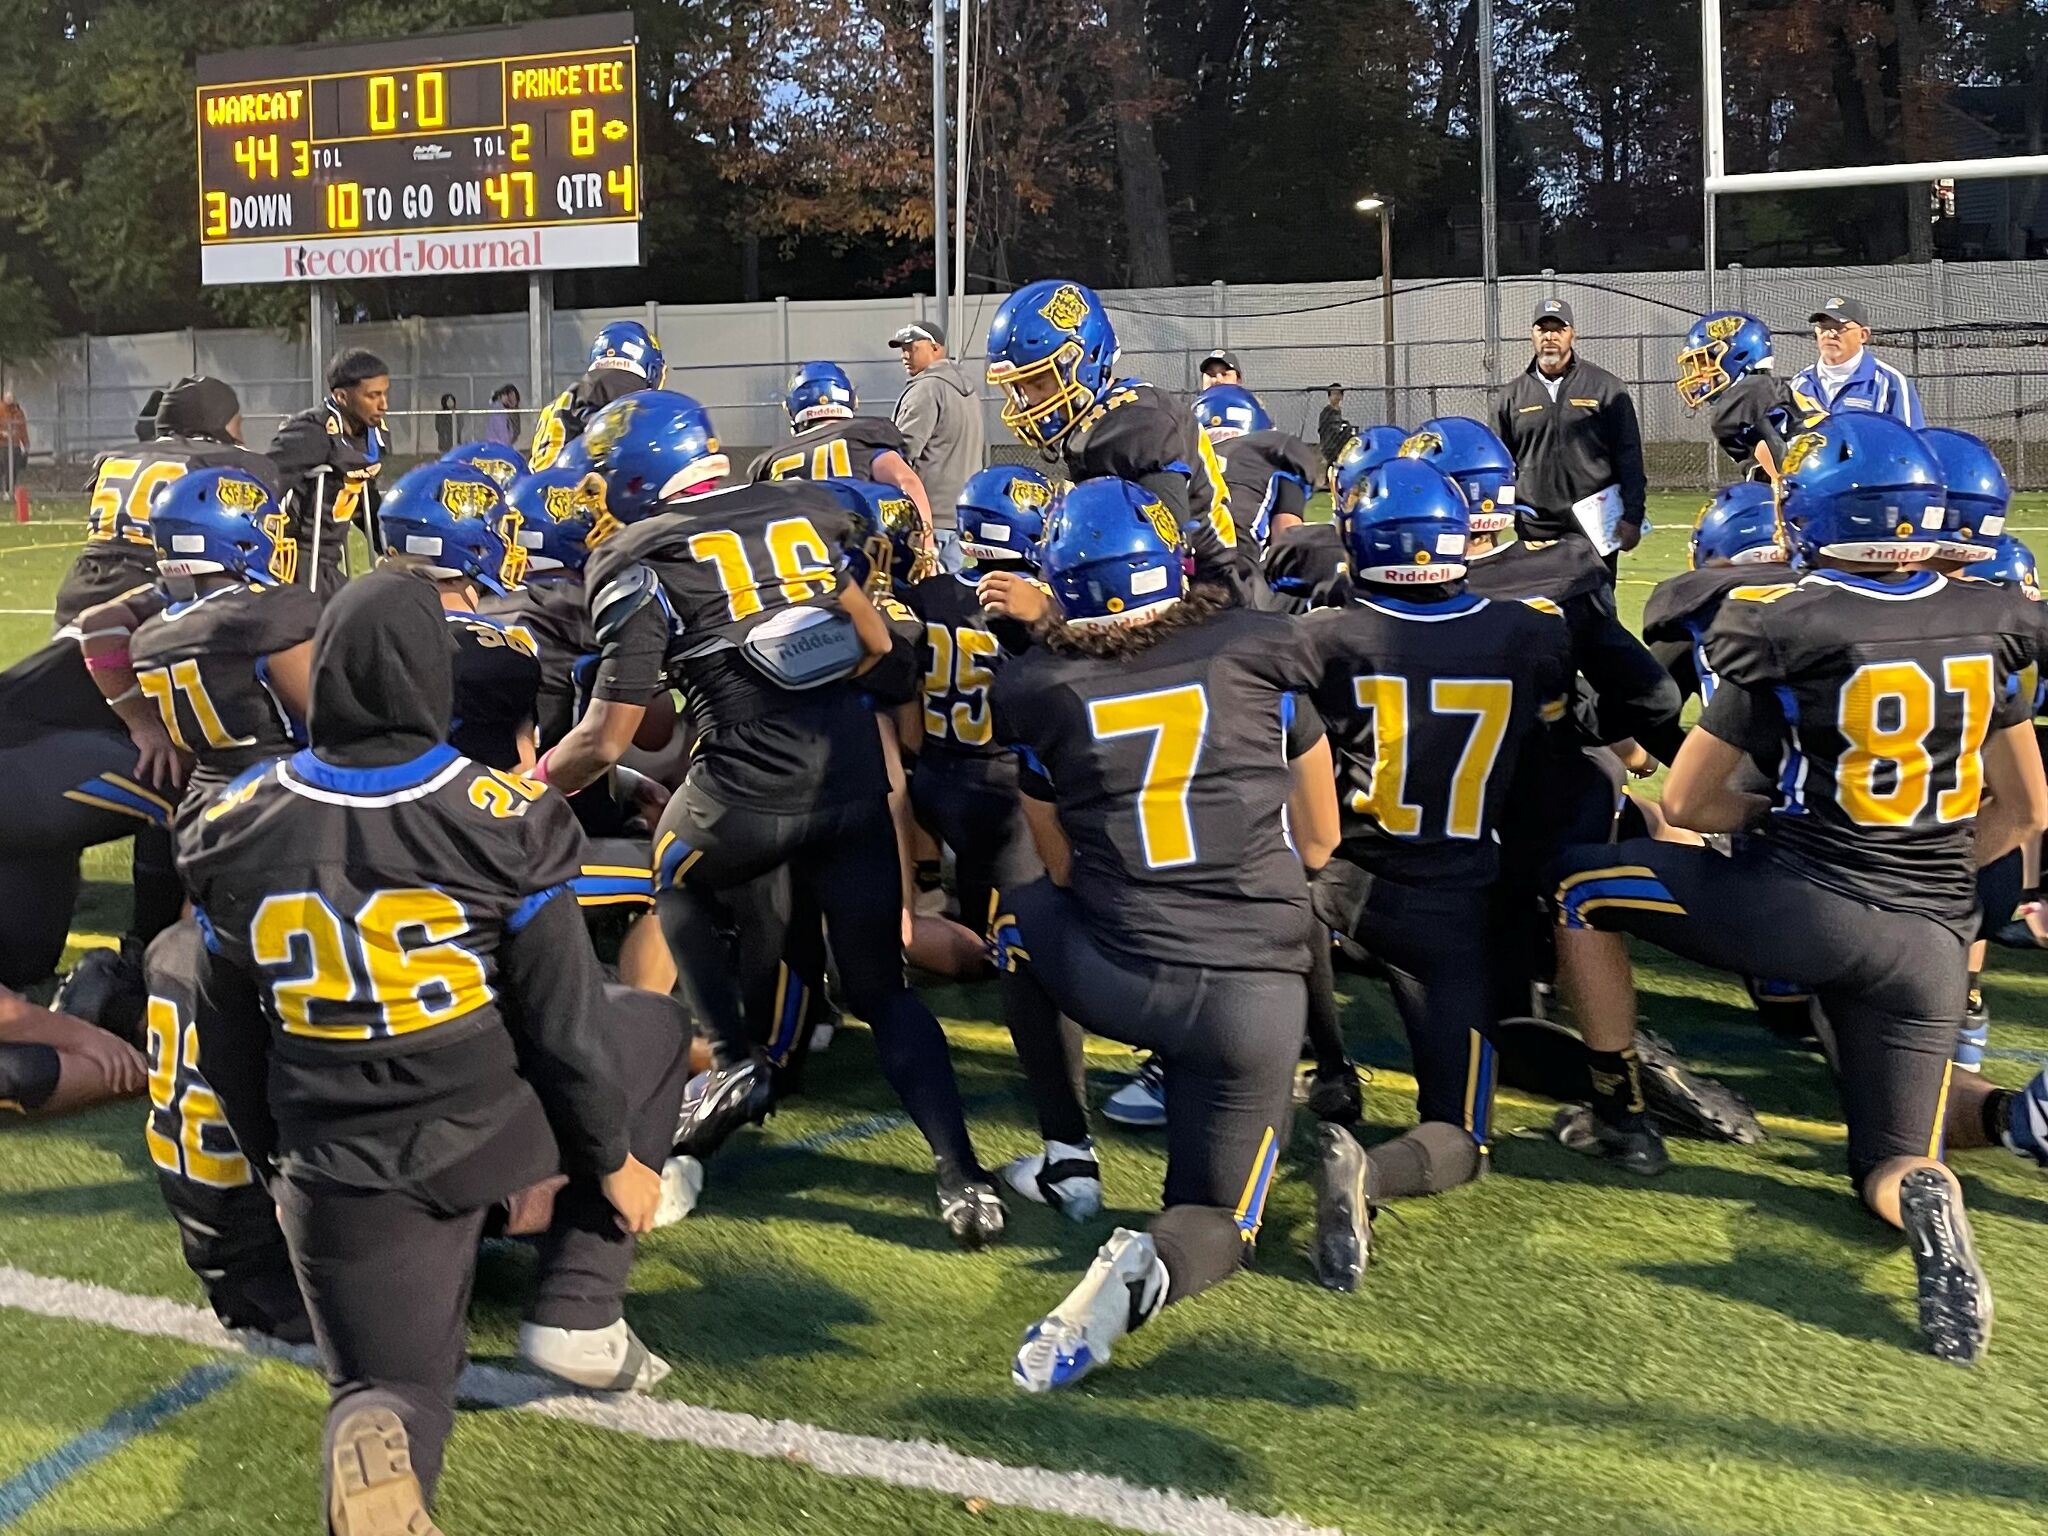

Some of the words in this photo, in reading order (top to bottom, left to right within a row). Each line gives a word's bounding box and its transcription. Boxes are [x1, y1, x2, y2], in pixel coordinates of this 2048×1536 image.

[206, 89, 303, 126] WARCAT
[369, 71, 443, 131] 0:0
[473, 135, 506, 158] TOL
[510, 122, 530, 162] 2
[570, 108, 595, 157] 8
[234, 133, 279, 180] 44
[290, 140, 310, 177] 3
[312, 147, 342, 169] TOL
[327, 182, 359, 229] 10
[362, 187, 393, 222] TO
[402, 183, 434, 220] GO
[448, 180, 482, 217] ON
[485, 171, 535, 219] 47
[556, 172, 604, 216] QTR
[607, 164, 633, 213] 4
[205, 191, 228, 237] 3
[229, 192, 293, 230] DOWN
[283, 230, 543, 278] Record-Journal
[806, 406, 844, 419] Riddell
[1470, 517, 1508, 530] ddell
[1384, 568, 1451, 583] Riddell
[1861, 547, 1931, 561] Riddell
[1936, 547, 1988, 561] iddell
[923, 621, 1000, 747] 25
[1352, 675, 1514, 841] 17
[1835, 653, 1996, 827] 81
[1087, 683, 1210, 869] 7
[249, 886, 495, 1041] 26
